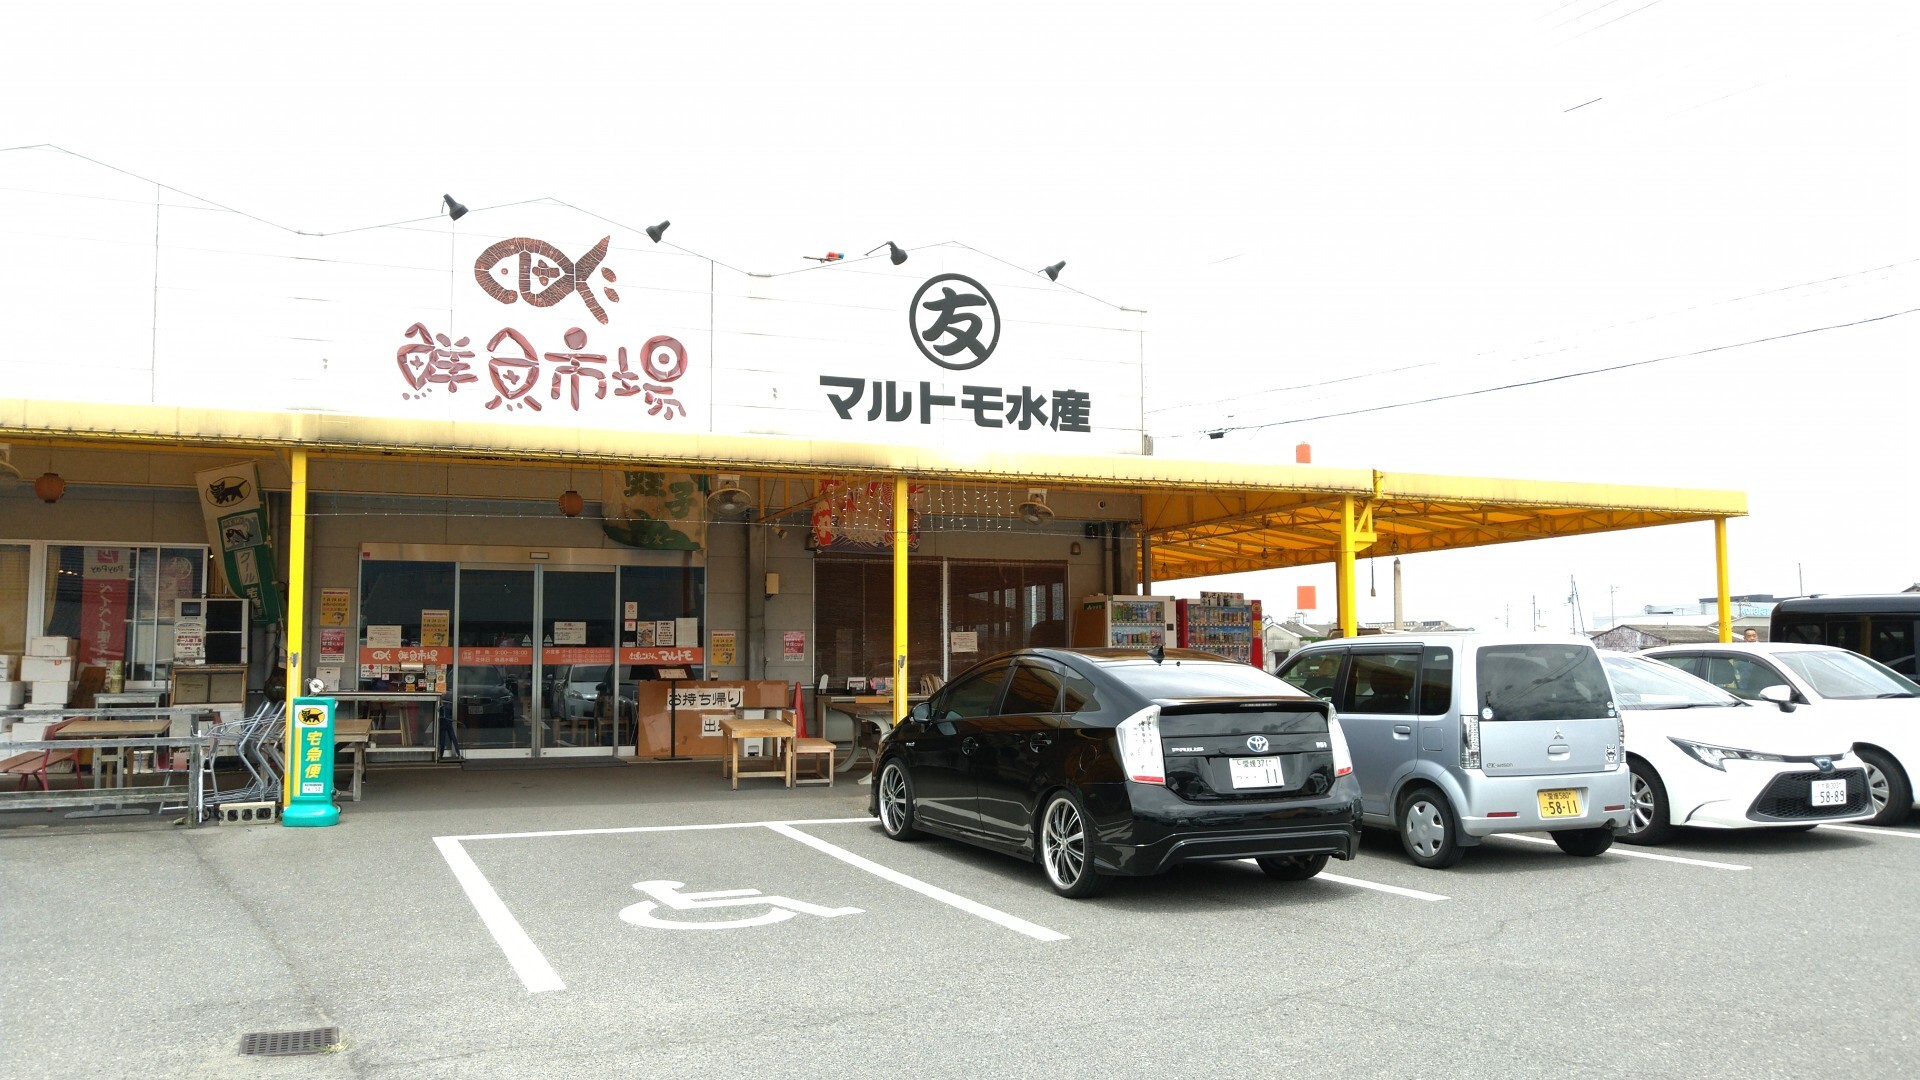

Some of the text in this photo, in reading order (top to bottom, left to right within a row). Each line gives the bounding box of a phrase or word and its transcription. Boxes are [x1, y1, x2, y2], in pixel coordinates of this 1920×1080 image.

[397, 322, 688, 420] 鮮魚市場
[819, 374, 1091, 433] マルトモ水産
[658, 650, 693, 661] マルトモ
[668, 690, 741, 707] お持ち帰り
[305, 730, 323, 778] 宅急便
[1820, 790, 1845, 803] 58-89
[1548, 800, 1578, 815] 58-11
